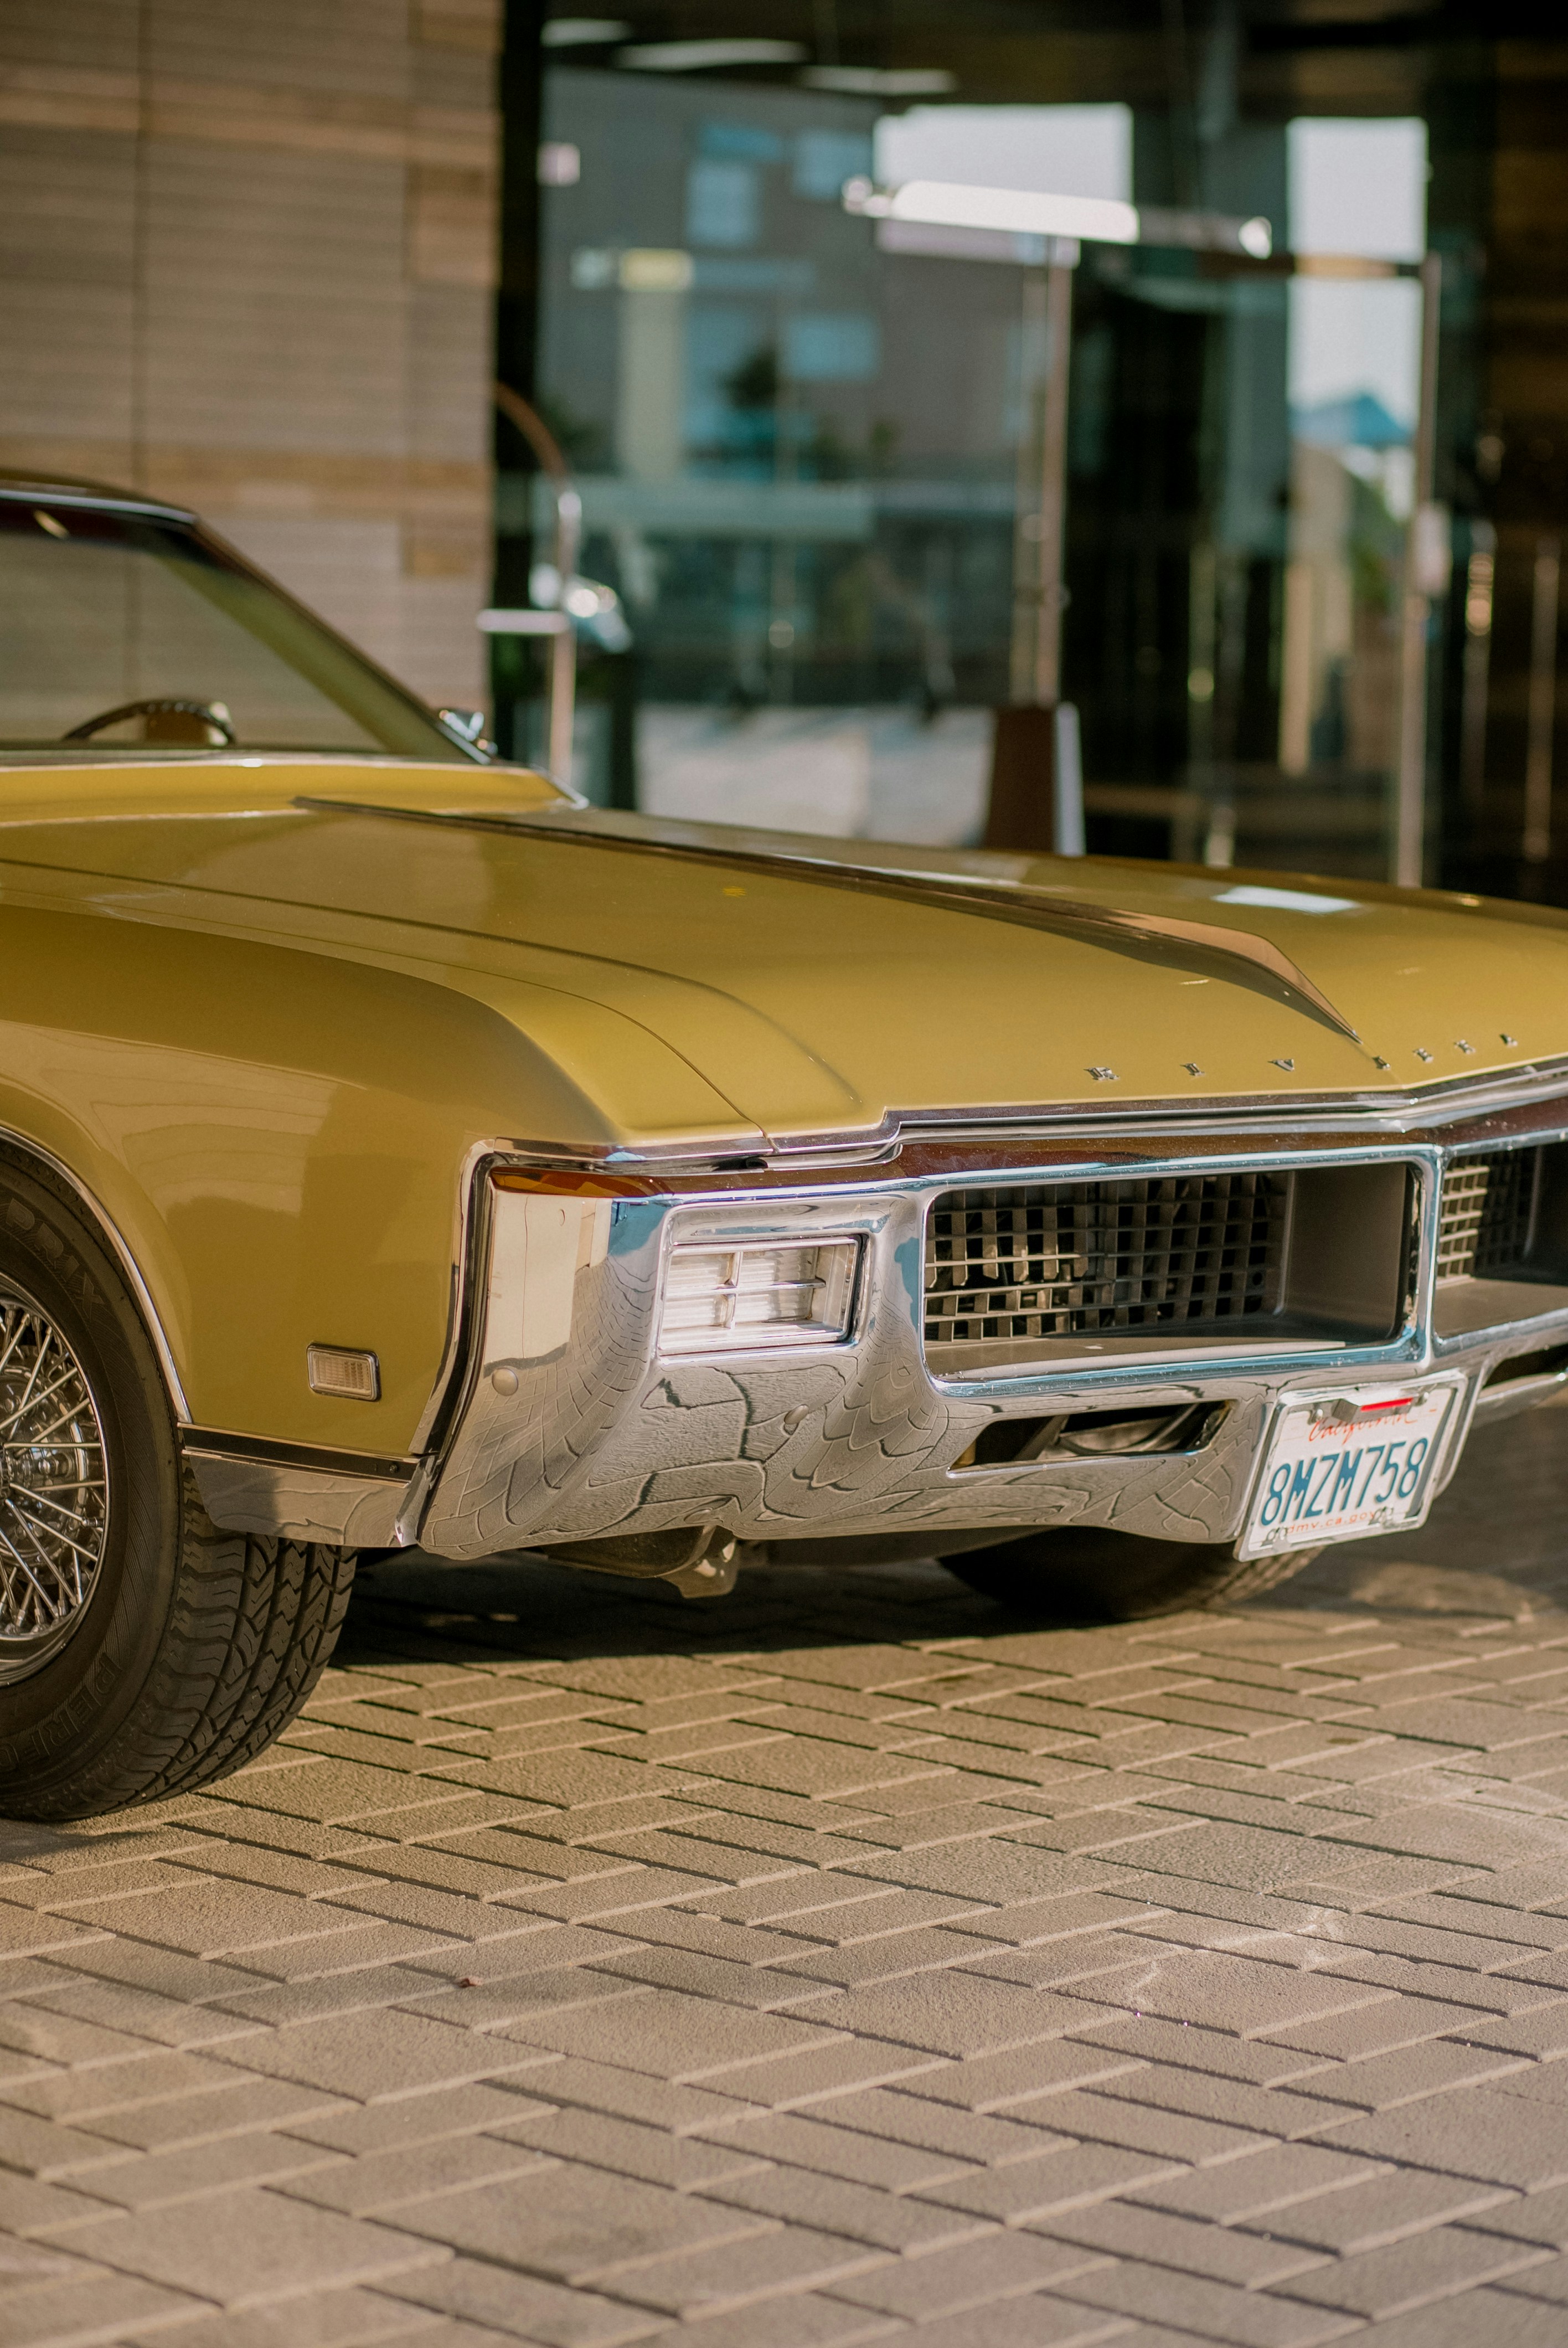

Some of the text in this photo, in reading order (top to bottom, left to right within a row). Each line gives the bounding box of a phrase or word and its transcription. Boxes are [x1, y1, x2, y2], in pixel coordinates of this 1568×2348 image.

[5, 1197, 106, 1320] PRIX
[1261, 1438, 1428, 1526] 8MZM758
[1287, 1510, 1375, 1534] dmv.ca.gov
